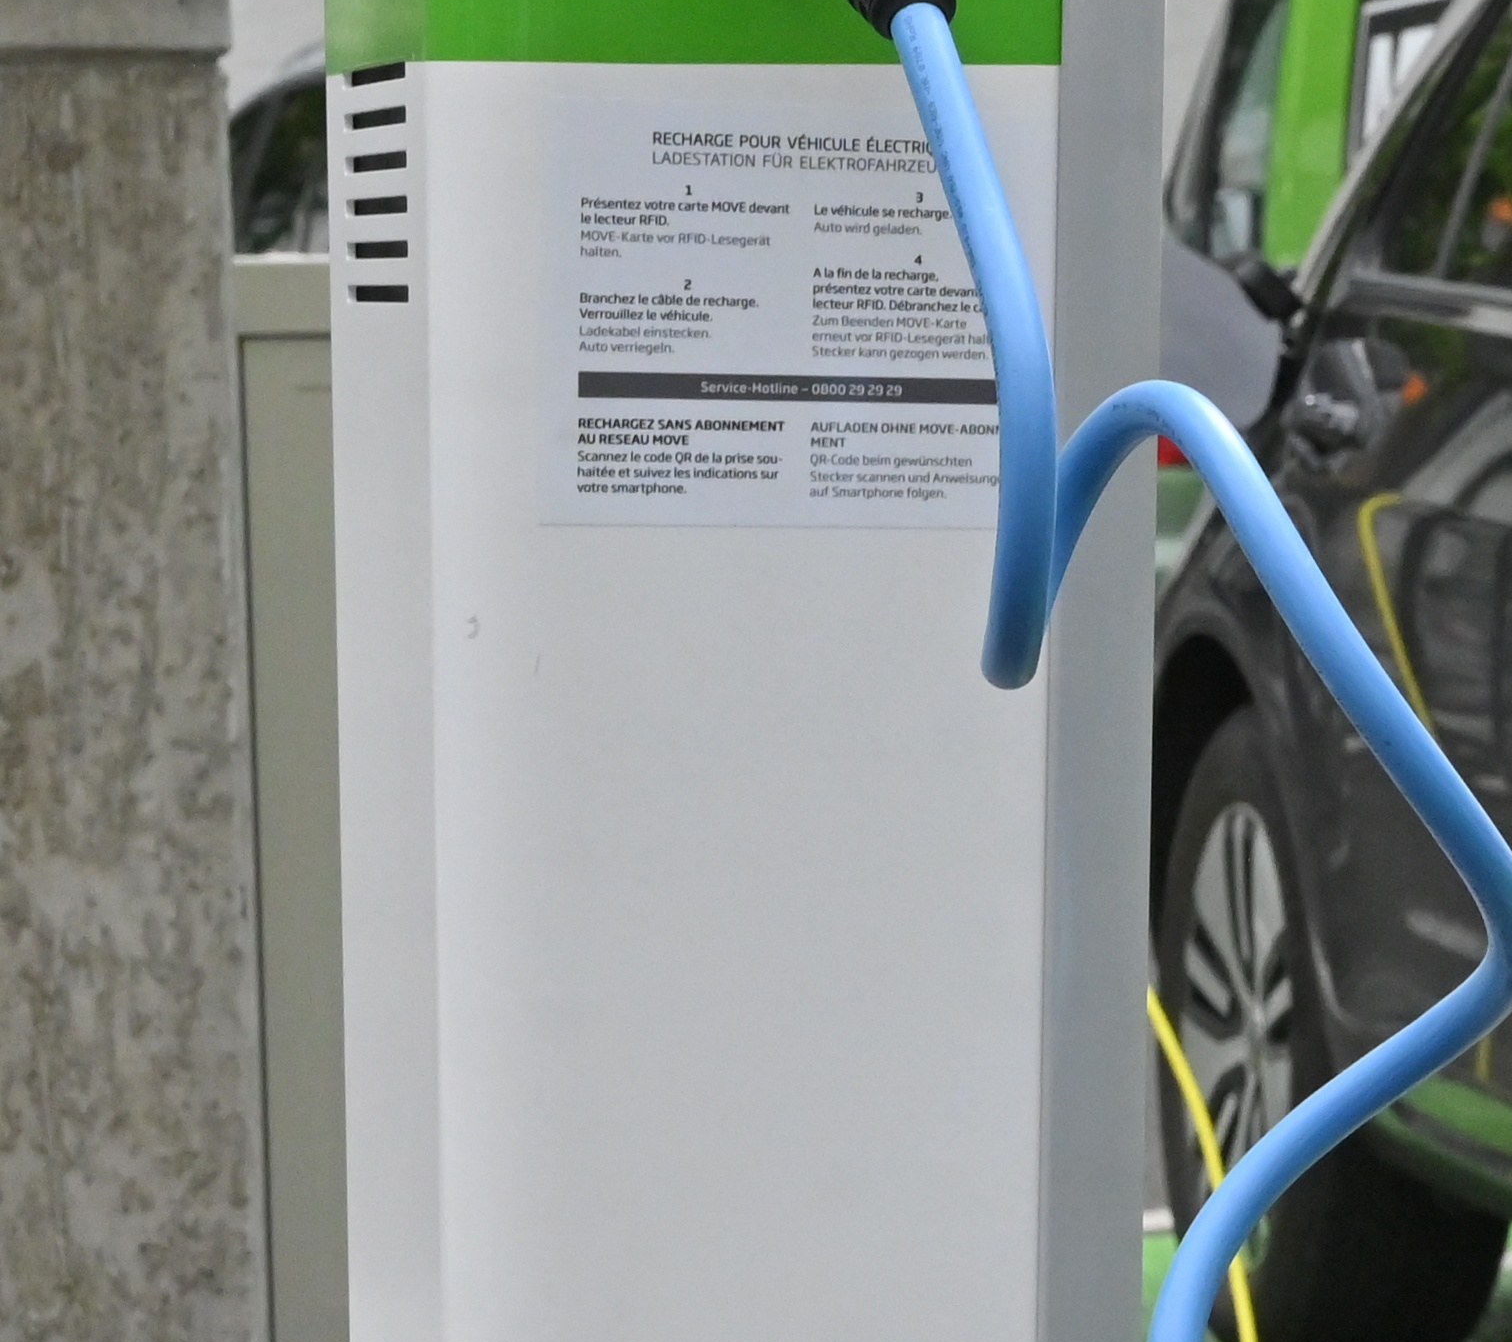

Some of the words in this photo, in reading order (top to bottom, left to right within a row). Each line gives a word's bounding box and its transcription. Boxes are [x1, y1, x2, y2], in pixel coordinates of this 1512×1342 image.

[652, 131, 734, 148] RECHARGE
[739, 134, 781, 149] POUR
[786, 133, 861, 152] VÉHICULE
[652, 150, 756, 168] LADESTATION
[762, 152, 793, 169] FÜR
[685, 184, 693, 196] 1
[916, 191, 924, 203] 3
[580, 196, 642, 210] Présentez
[644, 199, 676, 211] votre
[677, 201, 709, 212] carte
[711, 200, 746, 213] MOVE
[748, 201, 790, 215] devant
[814, 203, 828, 216] Le
[830, 204, 880, 218] véhicule
[881, 208, 896, 218] se
[897, 206, 953, 222] recharge.
[580, 212, 592, 224] le
[593, 212, 637, 225] lecteur
[639, 213, 670, 226] RFID.
[813, 221, 843, 233] Auto
[844, 221, 871, 234] wird
[872, 222, 923, 237] geladen.
[580, 230, 654, 243] MOVE-Karte
[656, 234, 676, 244] vor
[677, 232, 771, 249] RFID-Lesegerät
[580, 245, 622, 258] halten.
[914, 254, 923, 265] 4
[812, 267, 822, 278] A
[824, 266, 835, 279] la
[836, 267, 853, 279] fin
[854, 267, 870, 280] de
[871, 267, 882, 280] la
[884, 269, 939, 284] recharge,
[683, 278, 692, 291] 2
[812, 282, 872, 296] présentez
[873, 284, 905, 296] votre
[906, 285, 937, 297] carte
[579, 292, 636, 305] Branchez
[637, 293, 649, 305] le
[651, 293, 684, 306] câble
[685, 294, 701, 306] de
[703, 295, 759, 310] recharge.
[812, 297, 855, 310] lecteur
[856, 298, 886, 311] RFID.
[888, 299, 958, 312] Débranchez
[960, 300, 971, 313] le
[578, 307, 644, 320] Verrouillez
[646, 309, 657, 321] le
[659, 309, 713, 322] véhicule.
[811, 314, 839, 326] Zum
[841, 315, 894, 328] Beenden
[895, 316, 967, 330] MOVE-Karte
[579, 324, 641, 338] Ladekabel
[642, 326, 711, 339] einstecken.
[811, 331, 852, 342] erneut
[854, 333, 873, 343] vor
[875, 331, 966, 347] RFID-Lesegerät
[578, 340, 609, 353] Auto
[610, 341, 675, 356] verriegeln.
[811, 344, 856, 357] Stecker
[858, 346, 888, 358] kann
[889, 348, 940, 362] gezogen
[941, 348, 989, 360] werden.
[700, 380, 799, 395] Service-Hotline
[811, 383, 847, 396] 0800
[848, 383, 865, 396] 29
[867, 383, 884, 396] 29
[886, 384, 903, 397] 29
[577, 417, 655, 430] RECHARGEZ
[657, 418, 692, 431] SANS
[694, 419, 785, 432] ABONNEMENT
[810, 421, 879, 433] AUFLADEN
[880, 422, 916, 434] OHNE
[577, 433, 596, 445] AU
[598, 433, 650, 445] RESEAU
[652, 434, 689, 446] MOVE
[810, 436, 846, 448] MENT
[577, 450, 628, 463] Scannez
[630, 450, 642, 463] le
[643, 451, 673, 463] code
[674, 451, 692, 465] QR
[694, 452, 710, 464] de
[711, 451, 723, 464] la
[724, 452, 755, 466] prise
[756, 454, 783, 465] sou-
[809, 453, 860, 467] QR-Code
[861, 454, 892, 466] beim
[893, 455, 973, 469] gewünschten
[577, 465, 616, 478] haitée
[617, 467, 631, 478] et
[633, 466, 672, 478] suivez
[673, 466, 691, 479] les
[693, 467, 758, 479] indications
[760, 470, 779, 480] sur
[809, 470, 854, 483] Stecker
[855, 473, 906, 483] scannen
[907, 471, 931, 483] und
[576, 482, 609, 493] votre
[610, 481, 687, 496] smartphone.
[808, 485, 829, 497] auf
[831, 485, 904, 500] Smartphone
[906, 486, 947, 502] folgen.
